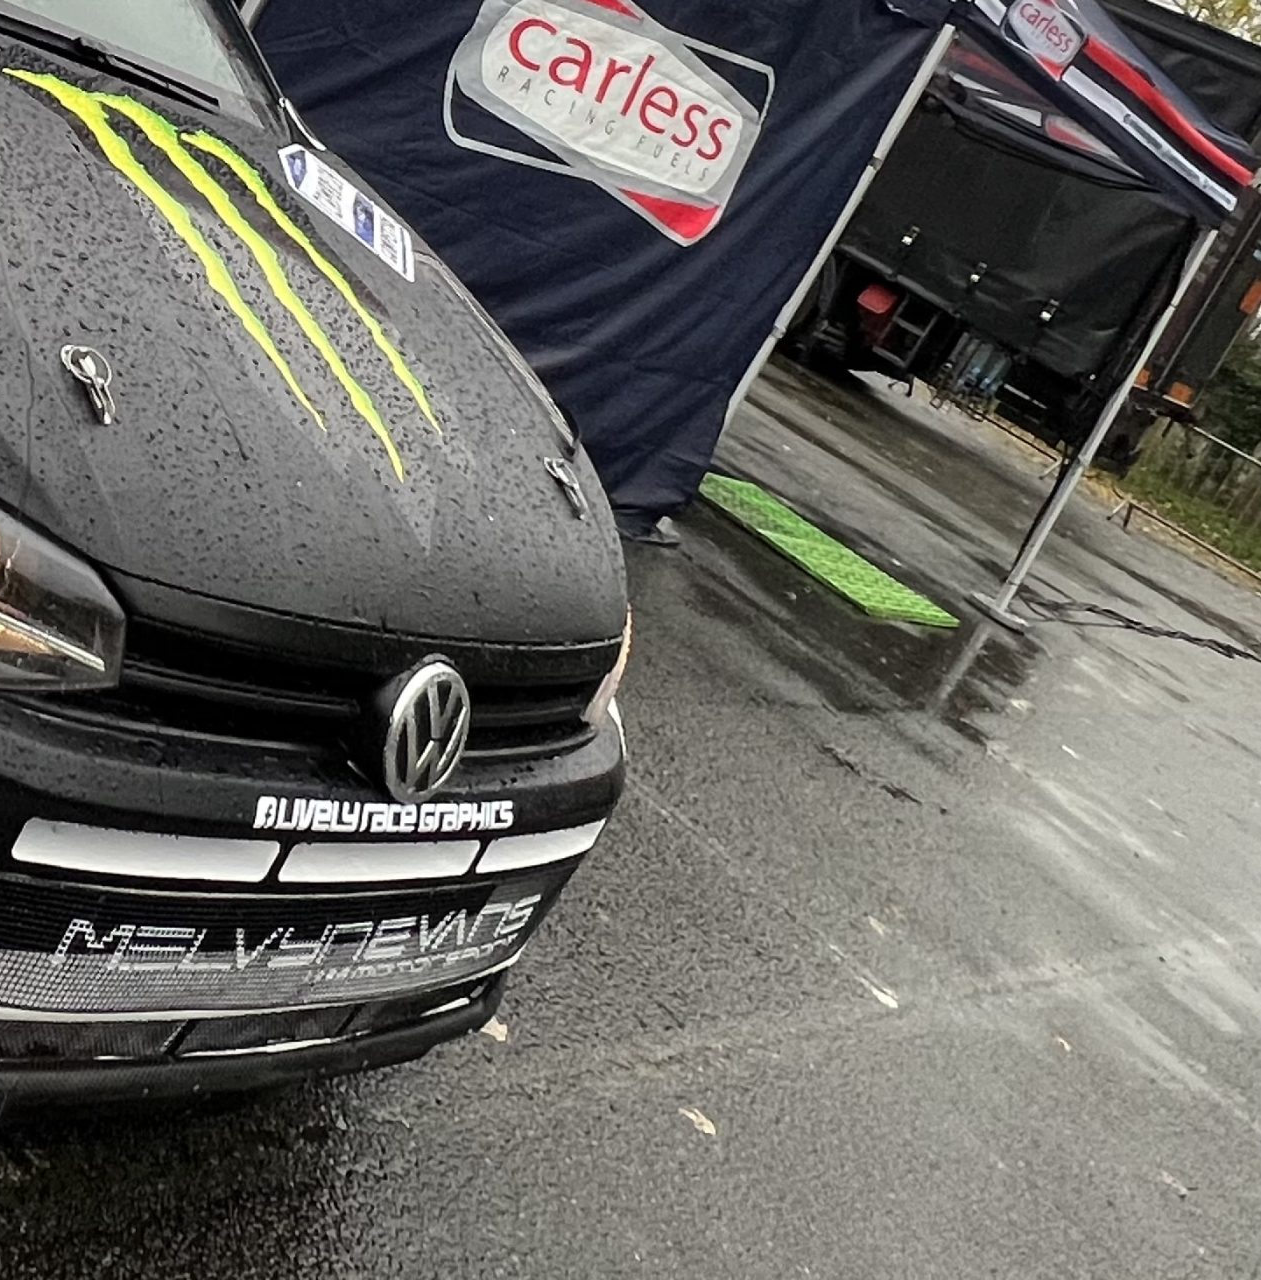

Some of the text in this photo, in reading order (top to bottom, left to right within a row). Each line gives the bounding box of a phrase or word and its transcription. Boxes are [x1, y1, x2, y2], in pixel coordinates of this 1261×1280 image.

[1019, 3, 1073, 53] carless
[498, 65, 709, 181] RACING FUELS
[508, 18, 731, 160] carless
